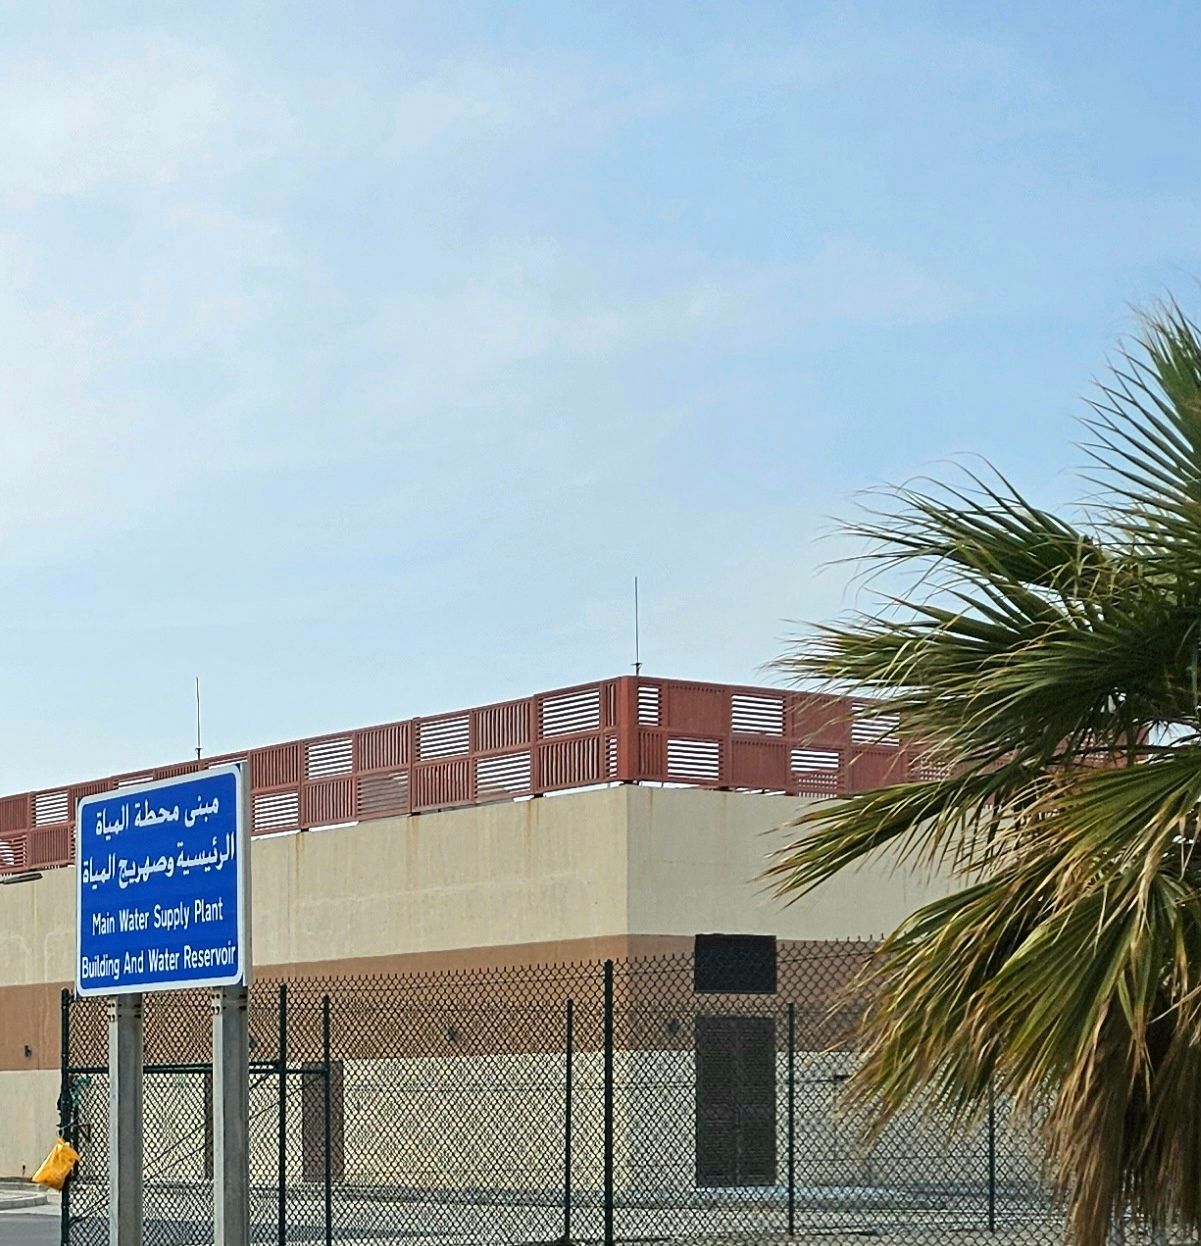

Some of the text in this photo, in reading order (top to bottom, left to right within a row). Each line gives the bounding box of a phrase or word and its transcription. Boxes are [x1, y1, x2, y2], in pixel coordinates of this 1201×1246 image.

[93, 898, 223, 935] Main Water Supply Plant
[82, 941, 235, 979] Building And Water Reservoir
